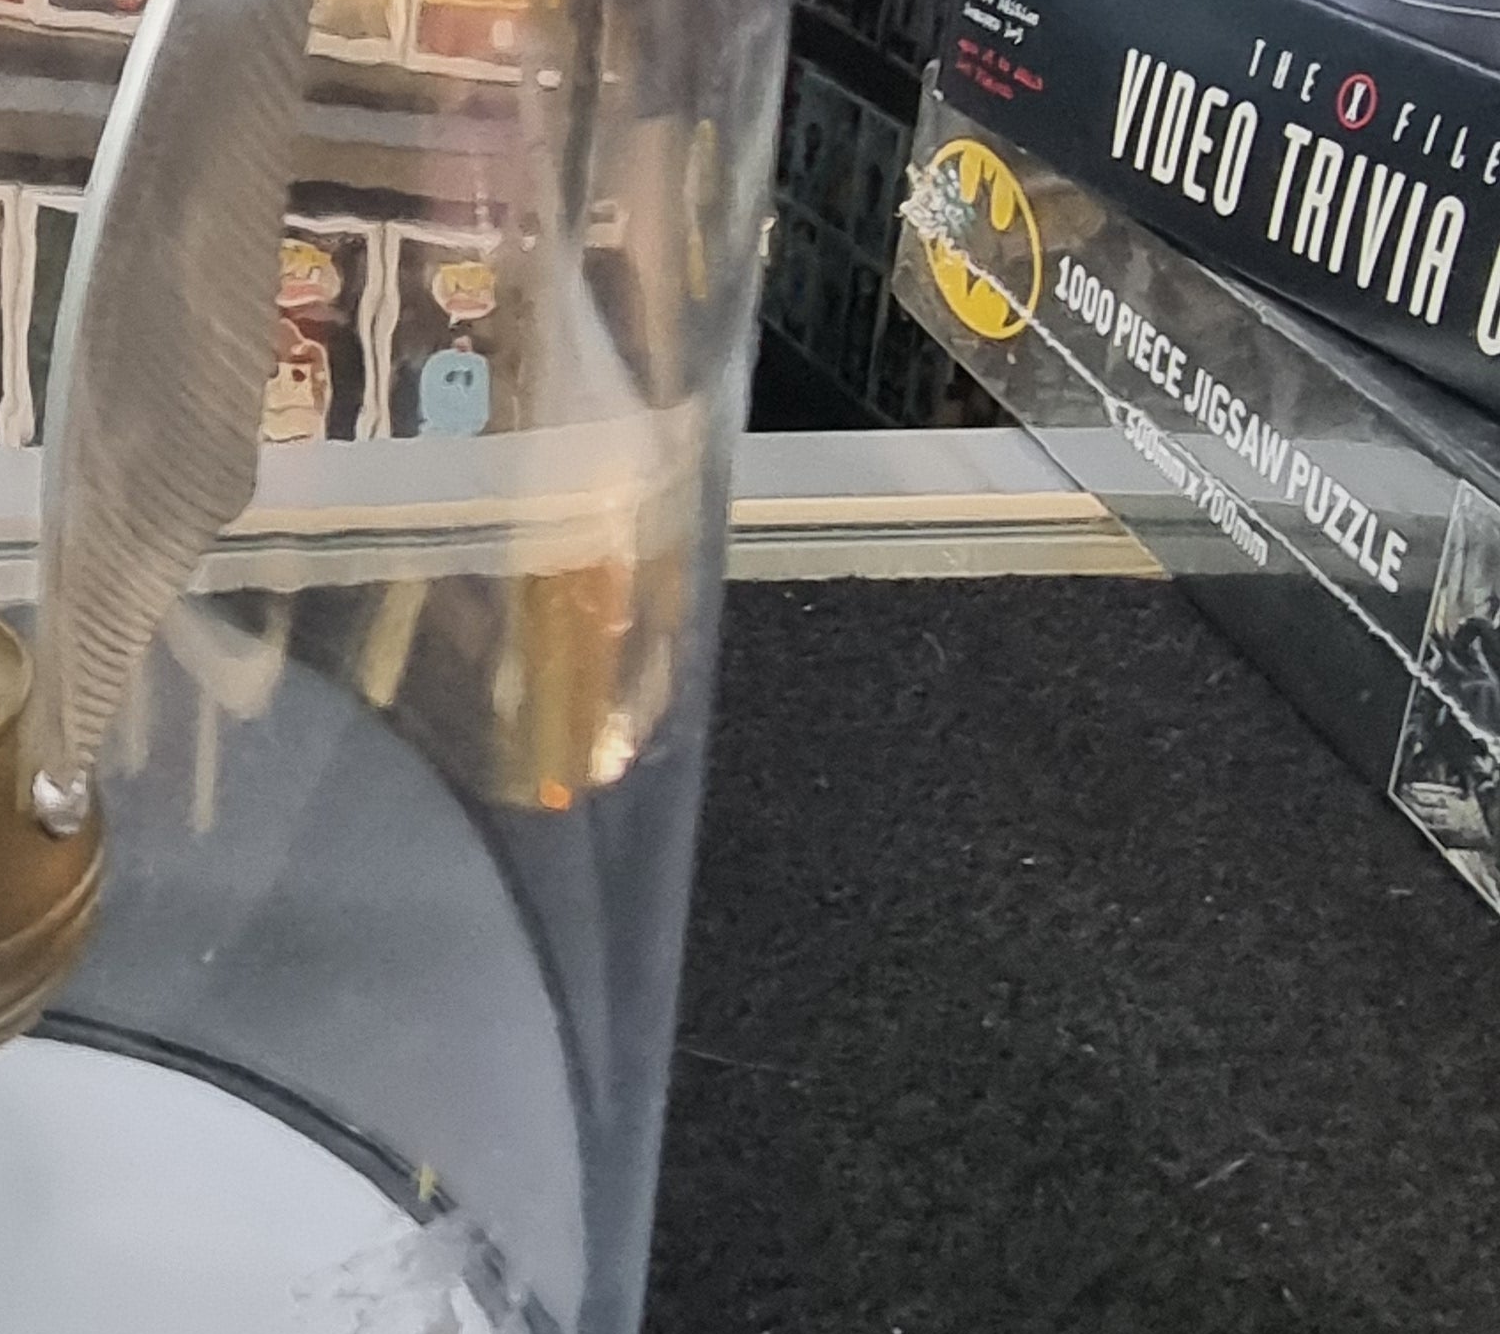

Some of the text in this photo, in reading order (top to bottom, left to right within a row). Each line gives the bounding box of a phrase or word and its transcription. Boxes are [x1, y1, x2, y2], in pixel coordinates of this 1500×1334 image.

[1111, 48, 1258, 217] VIDEO
[1266, 122, 1466, 325] TRIVIA
[1248, 38, 1322, 103] THE
[1345, 82, 1368, 122] X
[1054, 255, 1408, 594] 1000 PIECE JIGSAW PUZZLE
